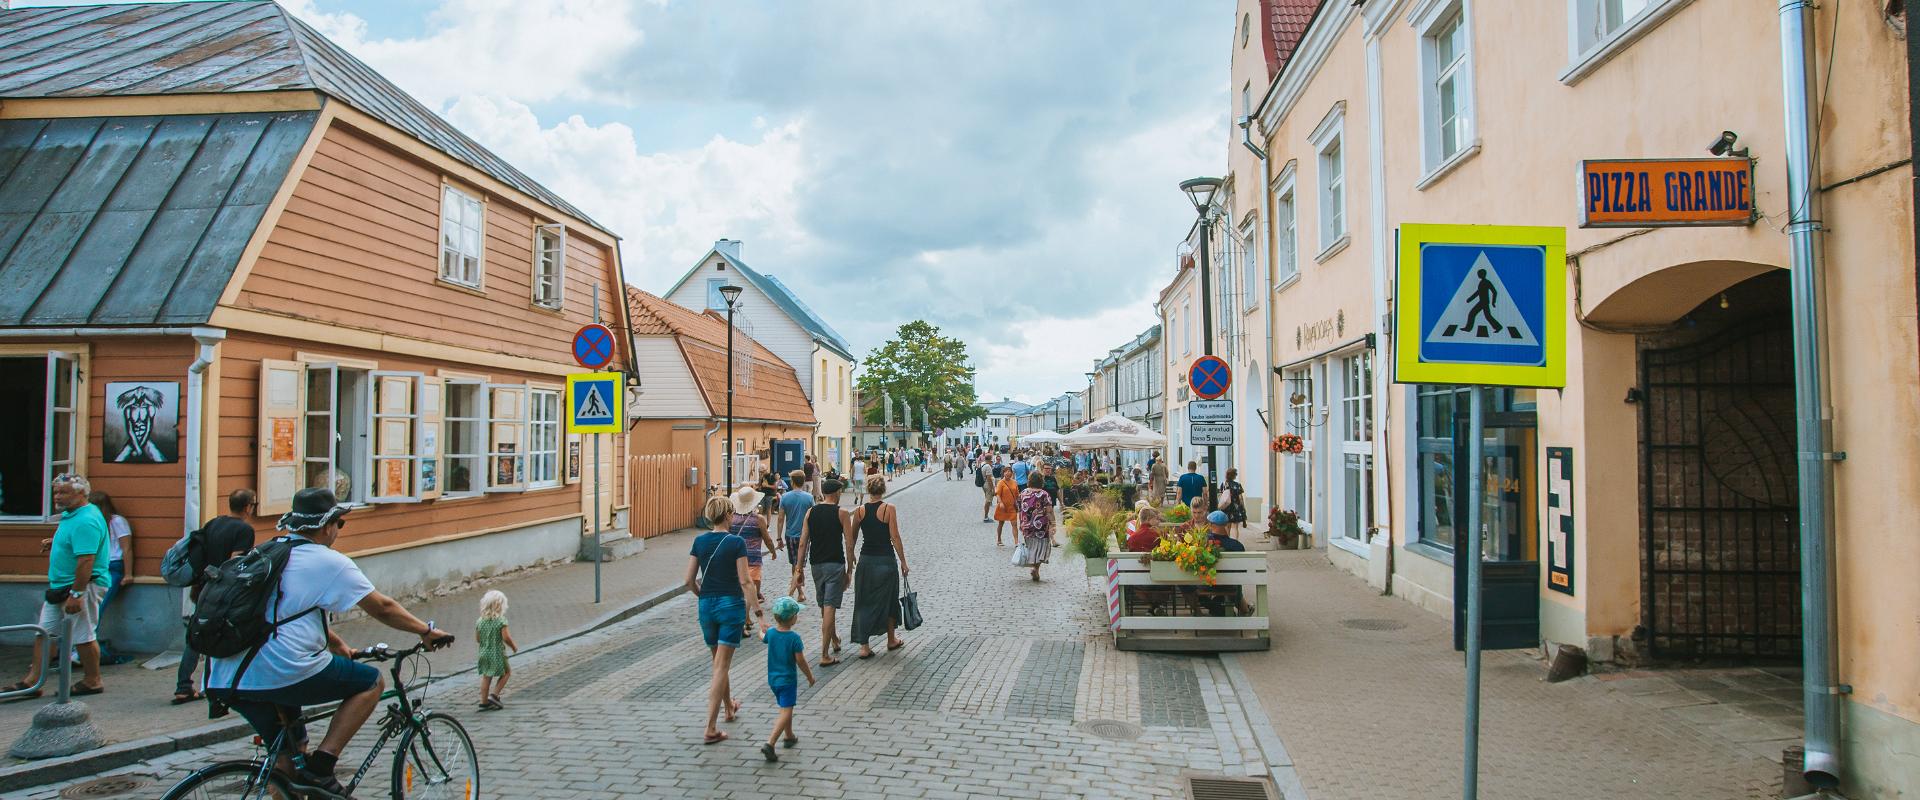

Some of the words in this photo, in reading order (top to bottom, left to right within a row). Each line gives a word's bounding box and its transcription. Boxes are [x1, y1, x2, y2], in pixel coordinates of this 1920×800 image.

[1588, 171, 1652, 213] PIZZA
[1664, 169, 1749, 212] GRANDE
[1206, 434, 1211, 442] 5
[354, 740, 385, 786] AUTHOR
